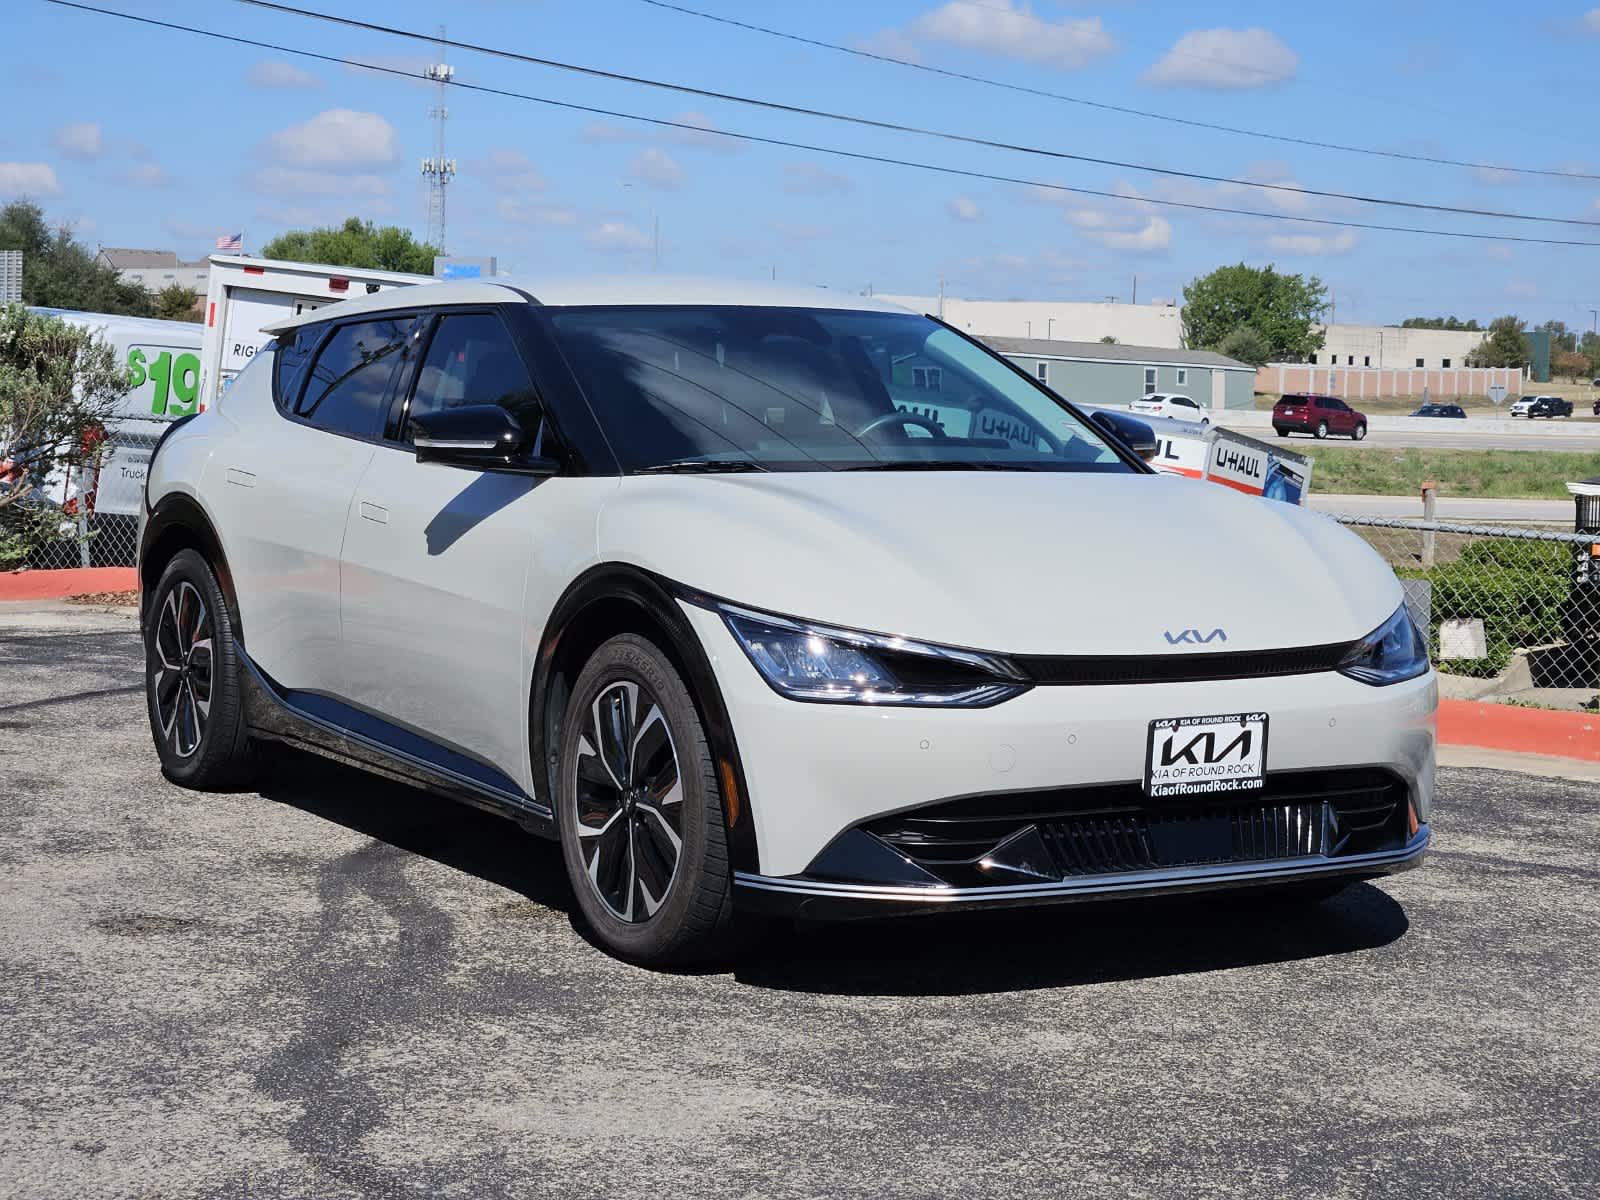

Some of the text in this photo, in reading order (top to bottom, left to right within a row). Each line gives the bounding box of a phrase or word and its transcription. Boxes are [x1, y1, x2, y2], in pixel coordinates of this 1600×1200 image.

[127, 347, 201, 416] $19
[1216, 446, 1261, 479] U-HAUL
[1164, 628, 1227, 645] KIA
[1155, 720, 1177, 728] KIA
[1201, 716, 1224, 724] ROUND
[1245, 713, 1267, 721] KIA
[1160, 730, 1252, 766] KIA
[1152, 763, 1255, 779] KIA OF ROUND ROCK
[1150, 779, 1263, 797] KiaofRoundRock.com
